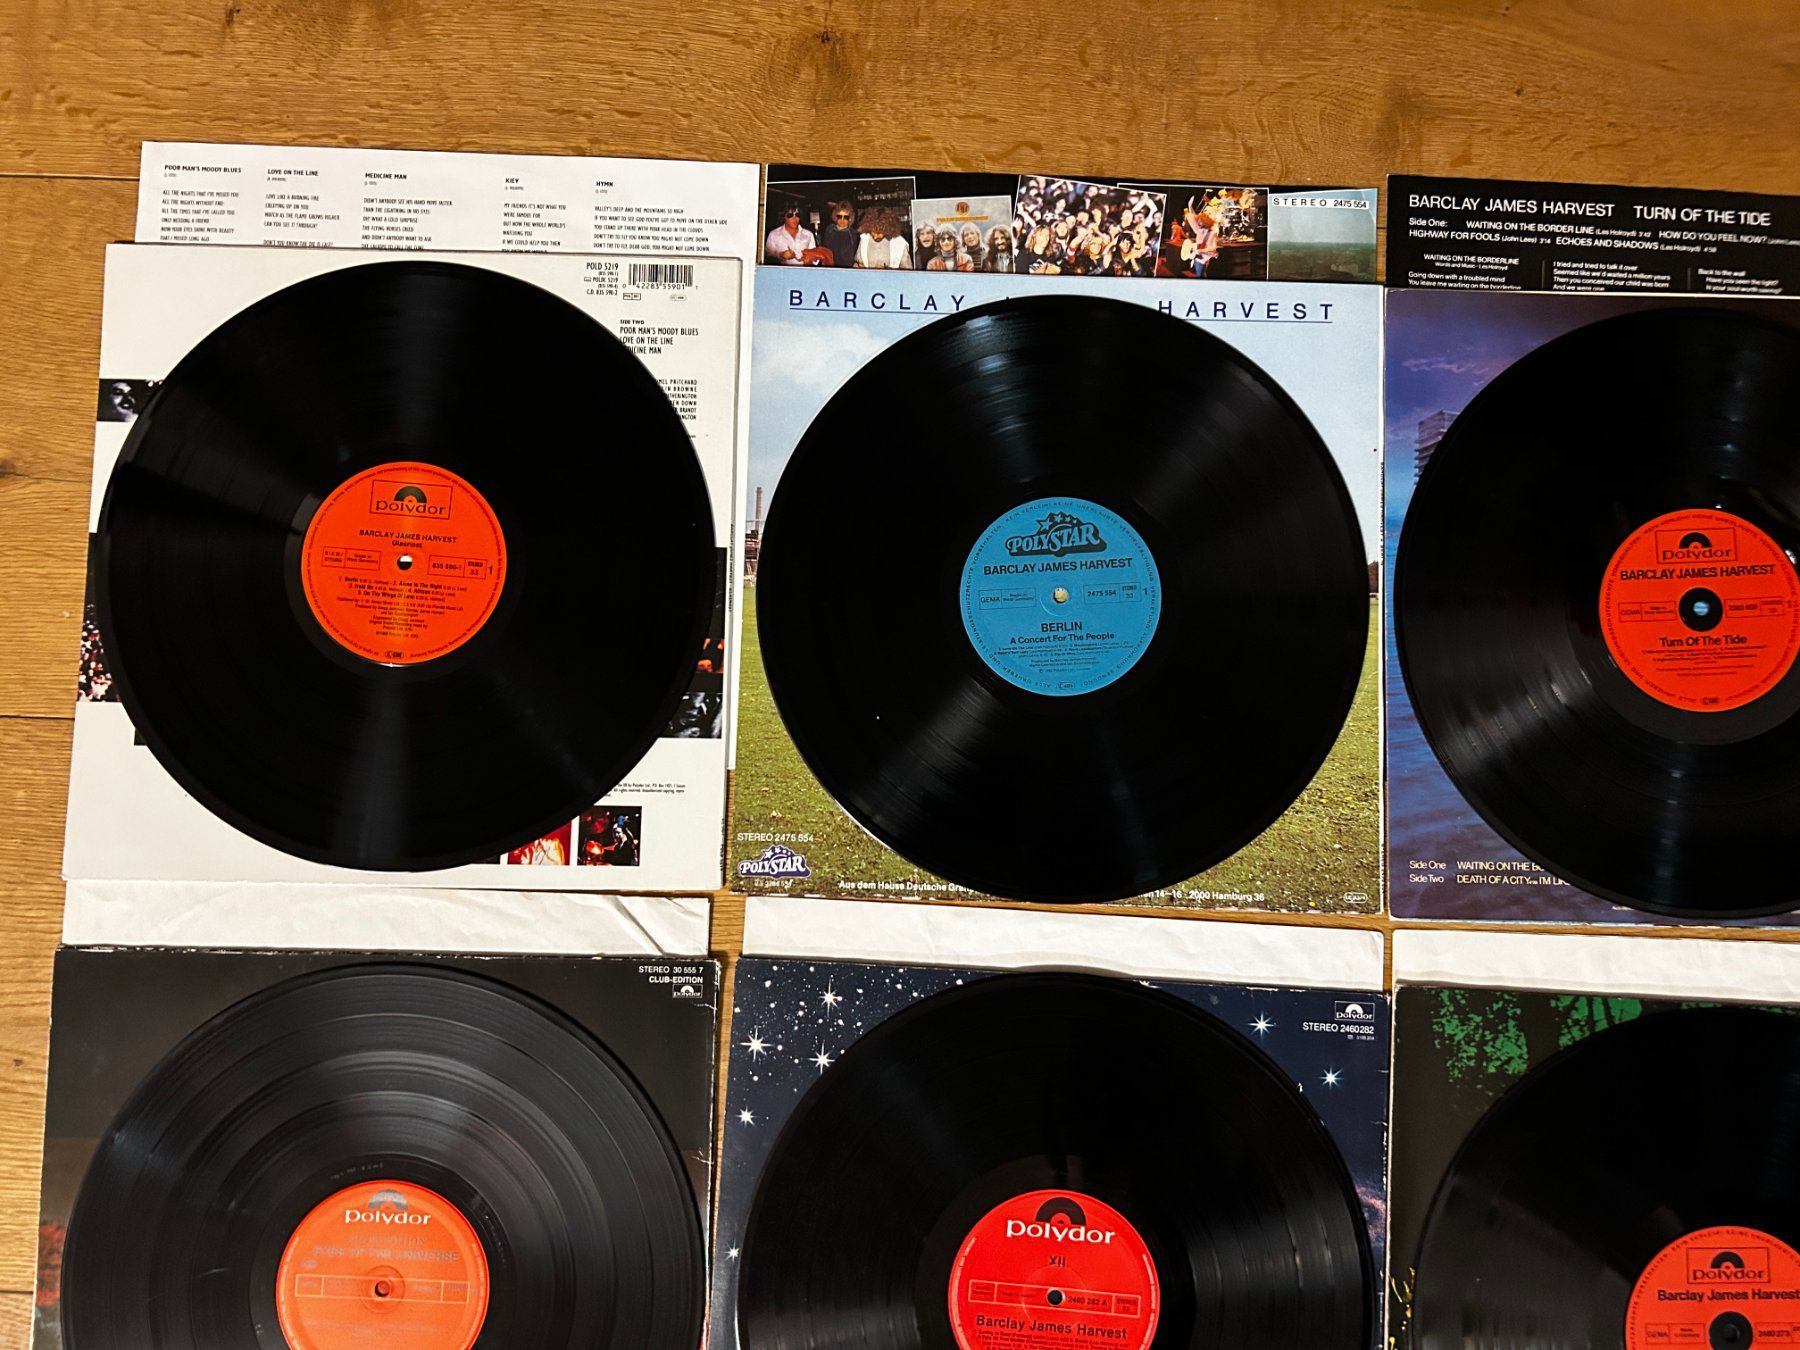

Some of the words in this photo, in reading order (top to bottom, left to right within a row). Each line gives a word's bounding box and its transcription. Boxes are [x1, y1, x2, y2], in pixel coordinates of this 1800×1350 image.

[1274, 198, 1326, 206] STEREO
[1409, 194, 1480, 210] BARCLAY
[1485, 199, 1537, 213] JAMES
[1543, 201, 1615, 217] HARVEST
[1633, 205, 1676, 220] TURN
[1680, 208, 1702, 222] OF
[1704, 210, 1735, 224] THE
[1738, 212, 1771, 226] TIDE
[1409, 218, 1426, 226] Side
[1428, 219, 1448, 227] One:
[1466, 220, 1502, 230] WAITING
[1504, 222, 1517, 230] ON
[1520, 223, 1536, 231] THE
[1537, 224, 1574, 234] BORDER
[1575, 225, 1594, 234] LINE
[1409, 230, 1449, 238] HIGHWAY
[1451, 232, 1469, 240] FOR
[1470, 232, 1500, 241] FOOLS
[1659, 230, 1681, 239] HOW
[1682, 232, 1696, 240] DO
[1699, 232, 1717, 241] YOU
[1718, 234, 1738, 242] FEEL
[1741, 235, 1767, 244] NOW?
[1556, 237, 1592, 246] ECHOES
[1594, 240, 1612, 248] AND
[1614, 241, 1658, 250] SHADOWS
[1477, 257, 1519, 265] BORDERLINE
[1408, 271, 1426, 279] Going
[789, 289, 965, 311] BARCLAY
[1158, 300, 1332, 319] HARVEST
[359, 529, 395, 538] BARCLAY
[395, 532, 420, 541] JAMES
[422, 534, 457, 543] HARVEST
[1006, 523, 1100, 553] POLYSTAR
[392, 539, 422, 548] Glasnost
[489, 565, 493, 574] 1
[983, 562, 1037, 576] BARCLAY
[1038, 561, 1077, 572] JAMES
[1080, 558, 1133, 570] HARVEST
[1620, 568, 1675, 581] BARCLAY
[1676, 567, 1717, 578] JAMES
[1719, 564, 1776, 577] HARVEST
[1041, 622, 1082, 632] BERLIN
[1018, 635, 1051, 644] Concert
[1086, 632, 1114, 640] People
[1686, 636, 1700, 645] Of
[1701, 636, 1720, 646] The
[1723, 635, 1747, 644] Tide
[737, 833, 773, 841] STEREO
[740, 856, 806, 874] POLYSTAR
[1410, 861, 1427, 869] Side
[1428, 861, 1446, 870] One
[1457, 861, 1495, 870] WAITING
[1496, 862, 1510, 870] ON
[1512, 862, 1529, 871] THE
[1410, 874, 1428, 883] Side
[1428, 874, 1444, 883] Two
[1457, 874, 1487, 884] DEATH
[1488, 875, 1501, 884] OF
[1502, 876, 1509, 884] A
[1510, 876, 1529, 884] CITY
[878, 882, 905, 890] Hause
[906, 882, 946, 891] Deutsche
[1189, 891, 1210, 900] 2000
[1212, 892, 1252, 901] Hamburg
[1302, 1022, 1338, 1032] STEREO
[1340, 1024, 1374, 1034] 2460282
[1050, 1256, 1066, 1267] XII
[1658, 1290, 1704, 1302] Barclay
[1708, 1290, 1748, 1300] James
[1752, 1289, 1800, 1300] Harvest
[977, 1314, 1025, 1331] Barclay
[1030, 1320, 1071, 1333] James
[1077, 1324, 1126, 1339] Harvest
